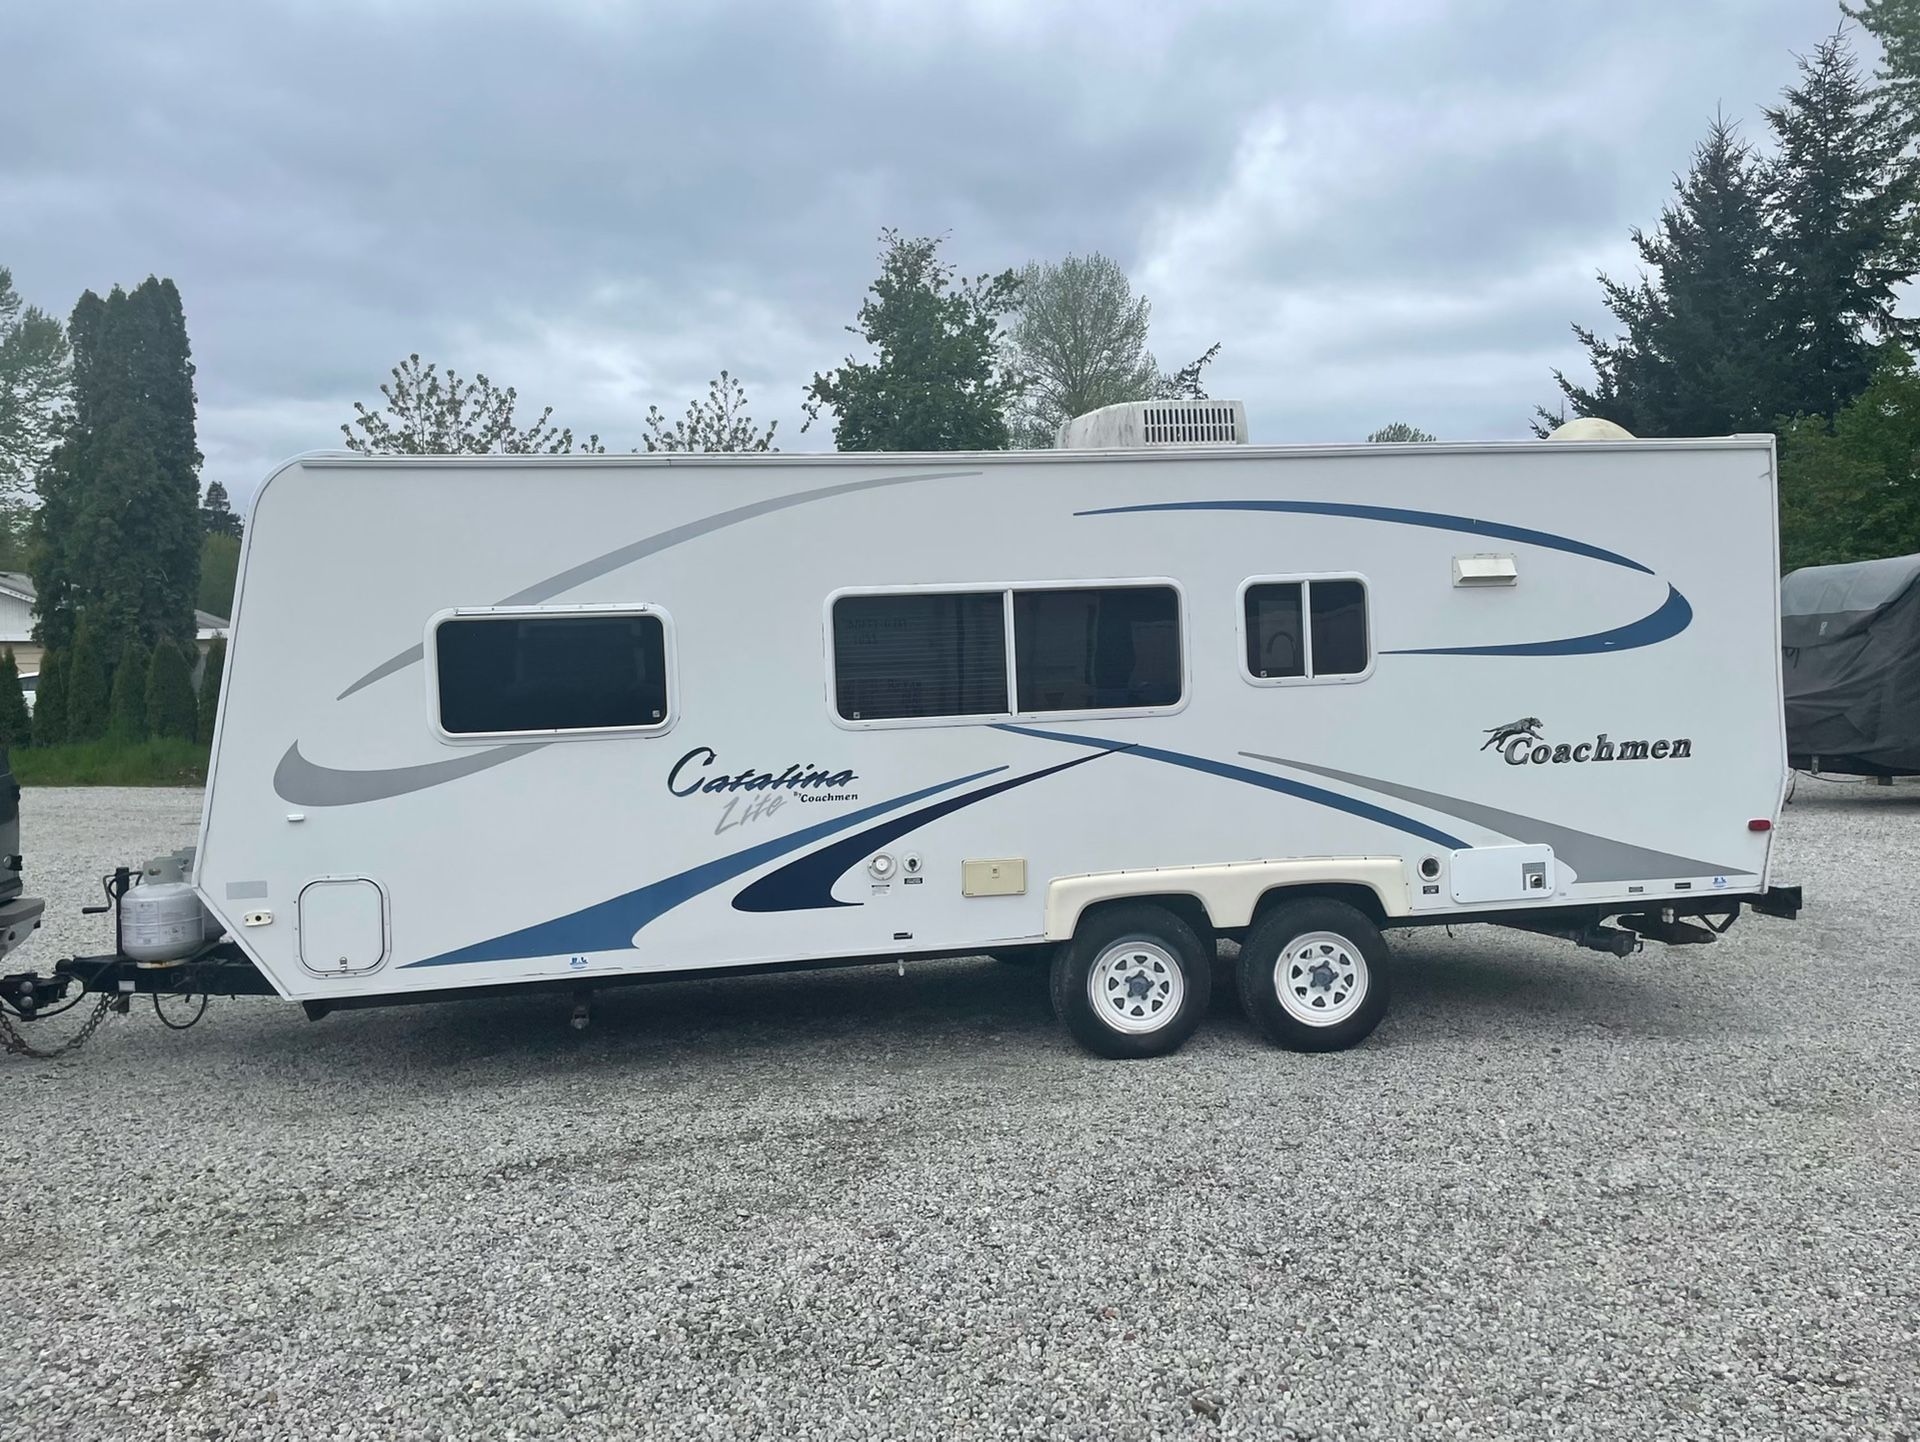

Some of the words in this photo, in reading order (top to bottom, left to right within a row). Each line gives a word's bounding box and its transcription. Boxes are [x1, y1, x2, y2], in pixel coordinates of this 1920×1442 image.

[1504, 733, 1692, 765] Coachmen
[667, 746, 859, 797] Catalina
[714, 793, 787, 836] Lite
[800, 793, 858, 802] Coachmen
